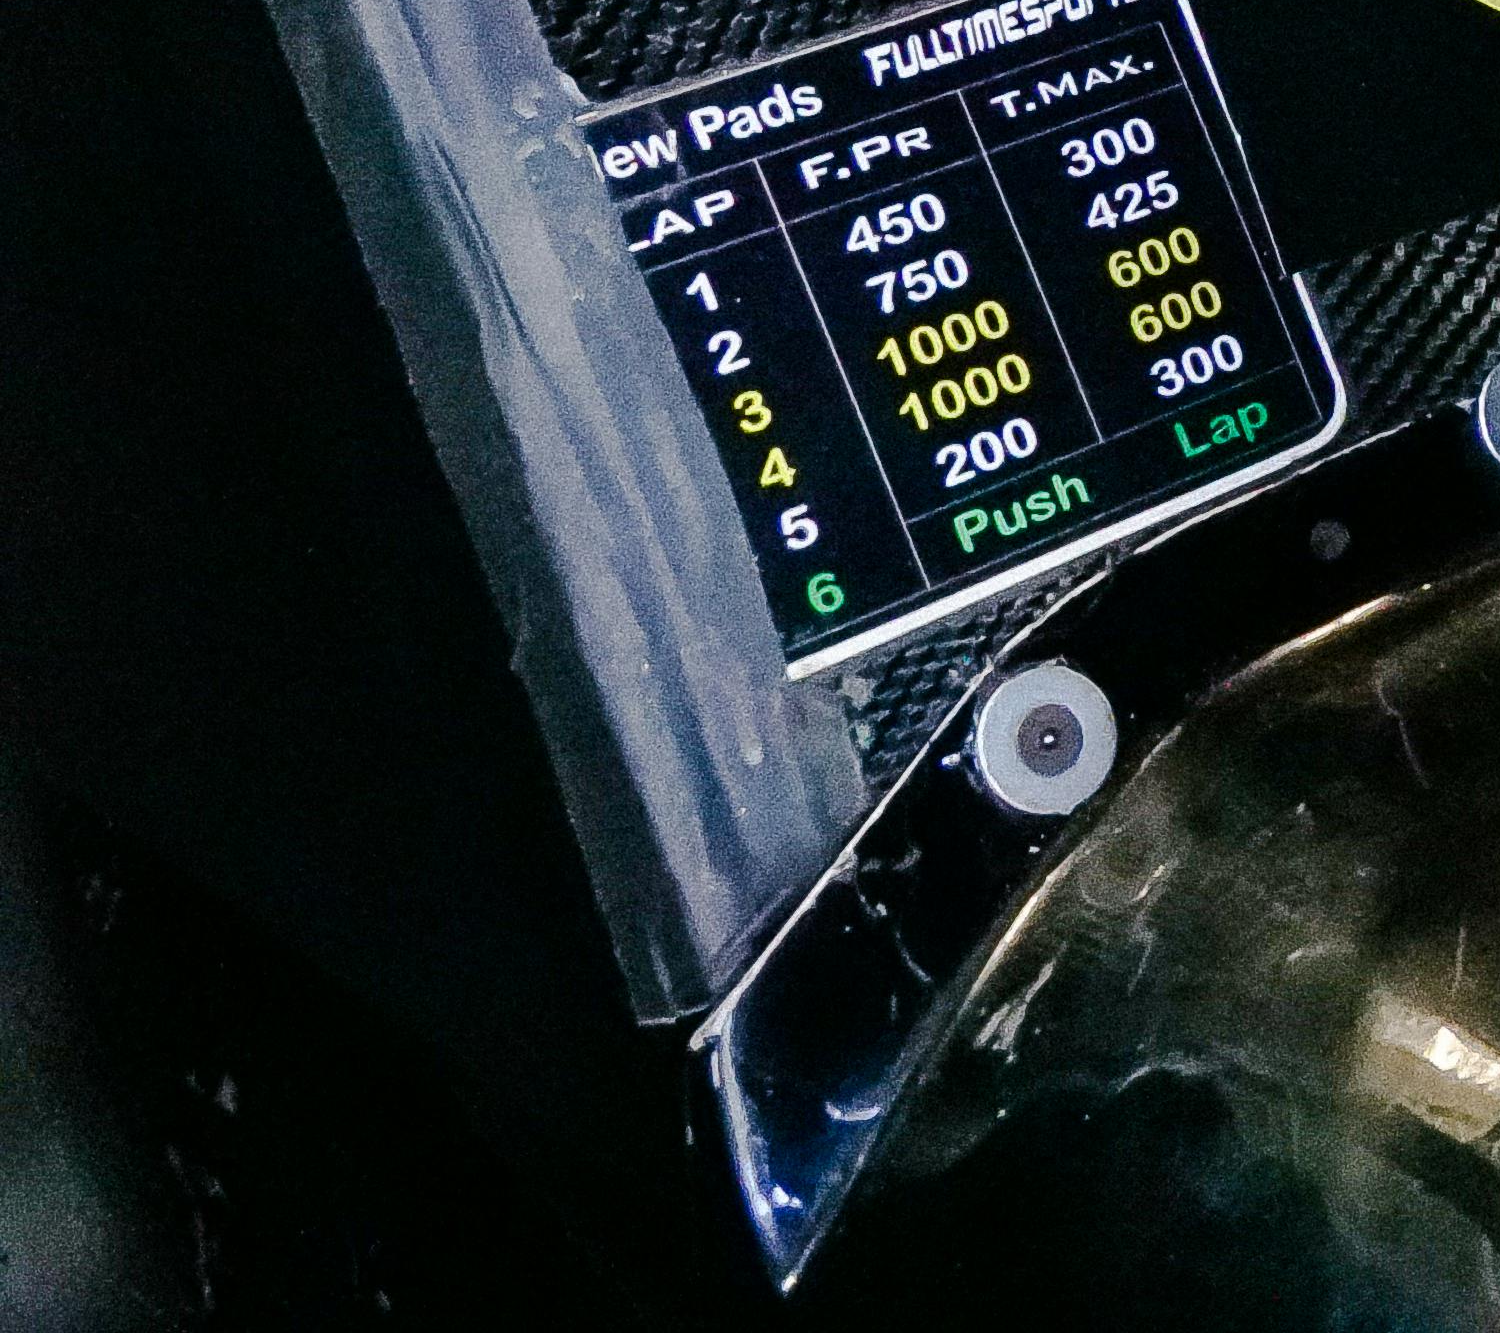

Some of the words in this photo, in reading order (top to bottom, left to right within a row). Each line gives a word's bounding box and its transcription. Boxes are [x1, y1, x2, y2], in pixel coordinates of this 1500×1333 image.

[588, 129, 677, 182] ew
[685, 84, 822, 150] Pads
[990, 55, 1153, 117] T.MAX.
[686, 272, 718, 311] 1
[845, 193, 945, 254] 450
[1061, 117, 1155, 177] 300
[707, 330, 750, 375] 2
[864, 250, 968, 313] 750
[1085, 171, 1178, 228] 425
[734, 390, 771, 433] 3
[877, 301, 1009, 376] 1000
[1109, 228, 1199, 287] 600
[760, 447, 796, 487] 4
[899, 354, 1030, 430] 1000
[1131, 282, 1221, 342] 600
[777, 503, 818, 551] 5
[935, 418, 1037, 487] 200
[1150, 335, 1243, 398] 300
[808, 573, 844, 615] 6
[950, 475, 1090, 553] Push
[1175, 403, 1267, 457] Lap
